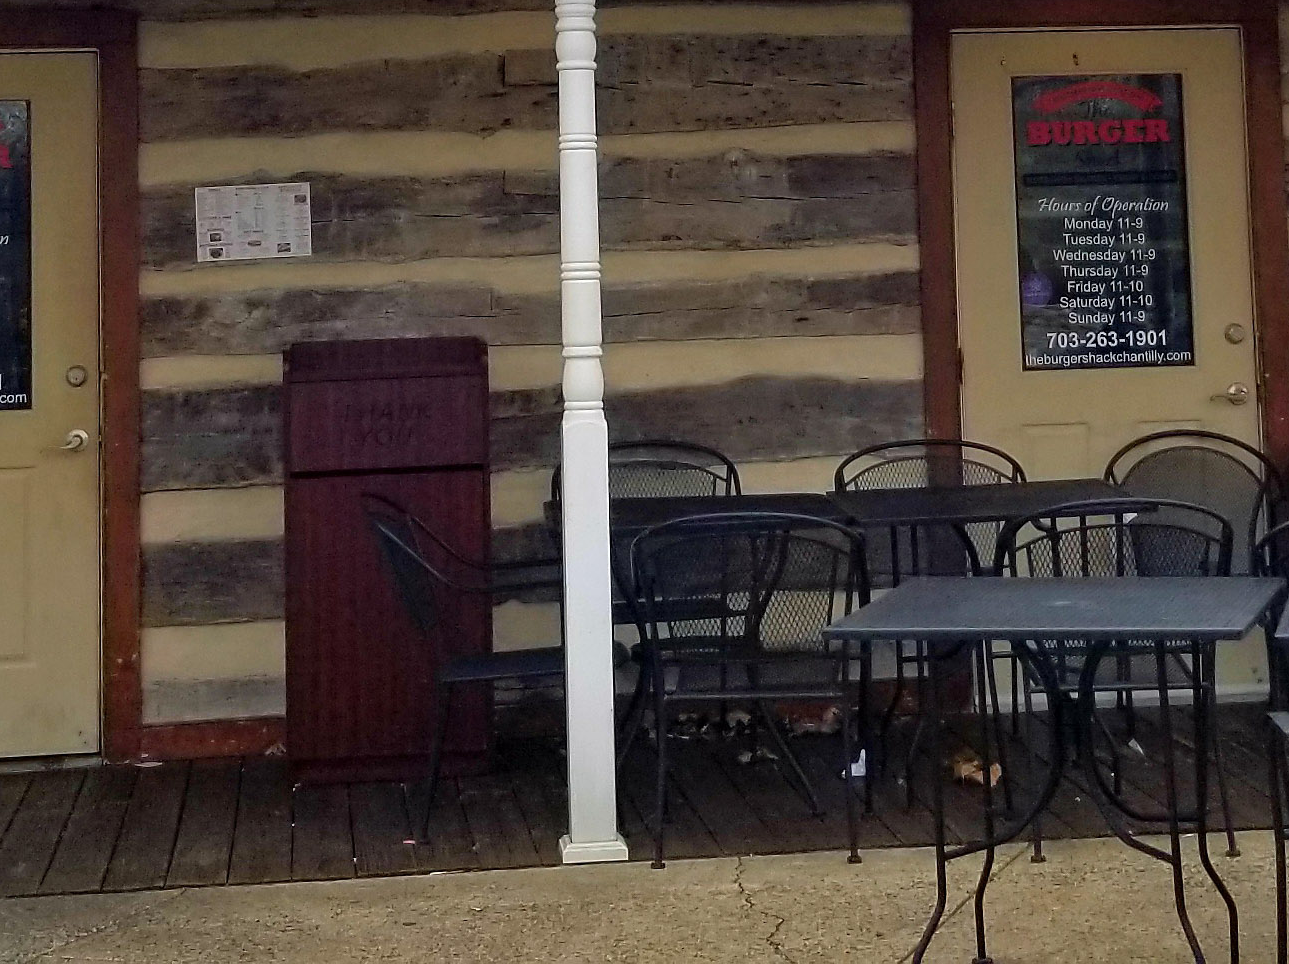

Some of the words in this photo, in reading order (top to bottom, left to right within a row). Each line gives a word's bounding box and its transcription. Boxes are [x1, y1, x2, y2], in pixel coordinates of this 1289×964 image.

[1026, 119, 1171, 146] BURGER
[1038, 197, 1081, 212] Hours
[1084, 195, 1101, 215] of
[1101, 197, 1169, 218] Operation
[1064, 217, 1113, 231] Monday
[1117, 217, 1143, 229] 11-9
[1063, 233, 1115, 247] Tuesday
[1119, 233, 1145, 245] 11-9
[1053, 249, 1126, 263] Wednesday
[1130, 248, 1156, 260] 11-9
[1061, 265, 1119, 279] Thursday
[1123, 264, 1149, 276] 11-9
[1067, 281, 1105, 294] Friday
[1109, 280, 1144, 292] 11-10
[1060, 296, 1115, 310] Saturday
[1119, 294, 1153, 306] 11-10
[1068, 312, 1115, 325] Sunday
[1119, 311, 1145, 322] 11-9
[1046, 329, 1167, 348] 703-263-1901
[1025, 349, 1191, 367] theburgershackchantilly.com
